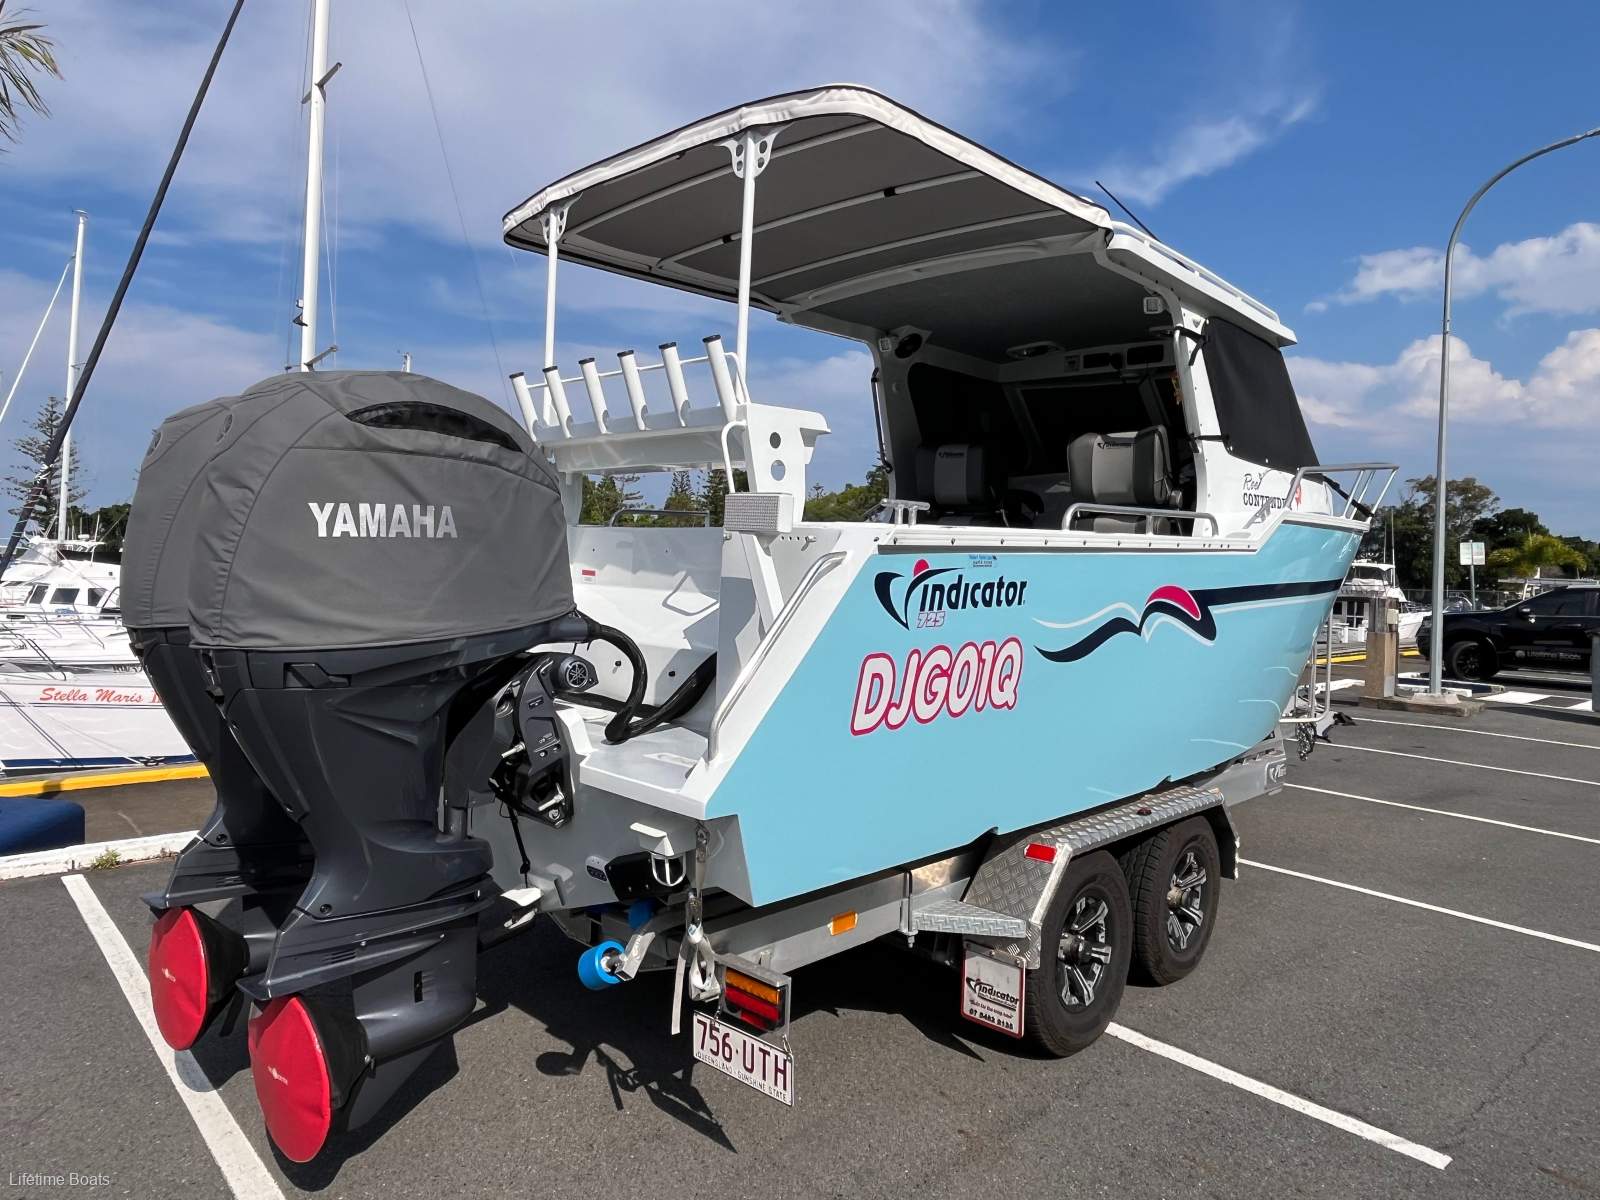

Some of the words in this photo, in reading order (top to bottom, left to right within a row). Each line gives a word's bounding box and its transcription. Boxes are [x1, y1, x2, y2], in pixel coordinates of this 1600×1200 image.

[307, 502, 458, 538] YAMAHA
[917, 611, 946, 628] 725
[40, 687, 89, 702] Stella
[95, 688, 143, 704] Maris
[737, 1071, 765, 1092] SUNSHINE
[768, 1085, 787, 1101] STATE
